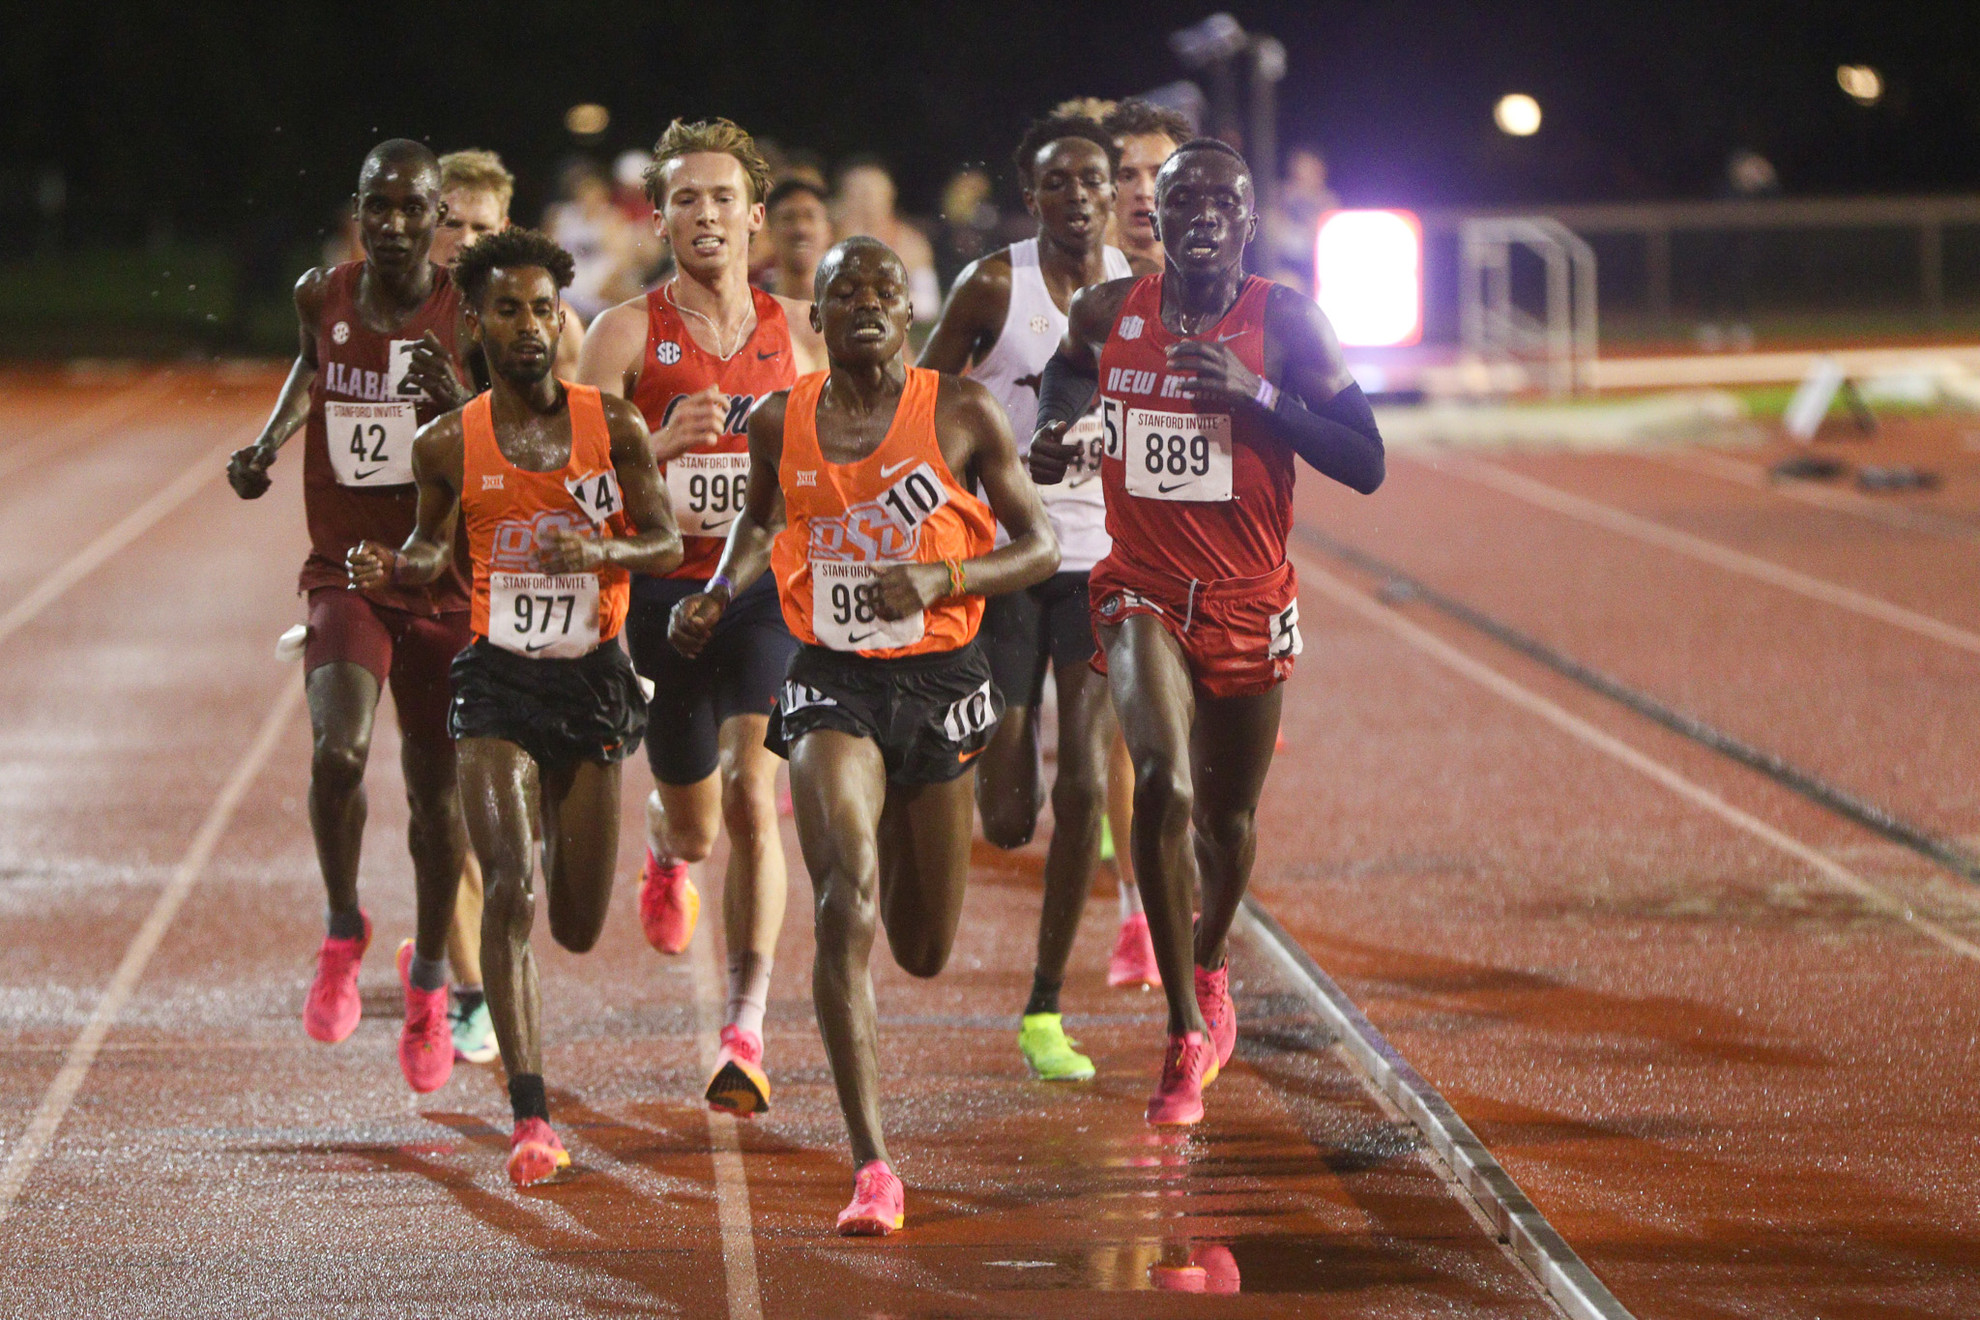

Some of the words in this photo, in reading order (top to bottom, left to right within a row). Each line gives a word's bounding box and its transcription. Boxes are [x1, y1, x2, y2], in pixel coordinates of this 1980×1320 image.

[657, 342, 681, 365] SEC
[326, 362, 392, 402] ALABA
[1107, 367, 1157, 395] NEW
[334, 405, 372, 418] STANFORD
[374, 405, 403, 417] INVITE
[1103, 401, 1118, 455] 5
[1138, 413, 1184, 429] STANFORD
[1186, 415, 1219, 430] INVITE
[350, 424, 389, 462] 42
[1145, 433, 1210, 476] 889
[680, 457, 729, 469] STANFORD
[595, 474, 614, 513] 4
[689, 474, 747, 513] 996
[885, 472, 939, 526] 10
[503, 576, 552, 590] STANFORD
[555, 576, 587, 590] INVITE
[822, 563, 871, 578] STANFORD
[514, 594, 575, 635] 977
[831, 583, 882, 625] 98
[1277, 606, 1295, 658] 5
[952, 691, 985, 736] 10
